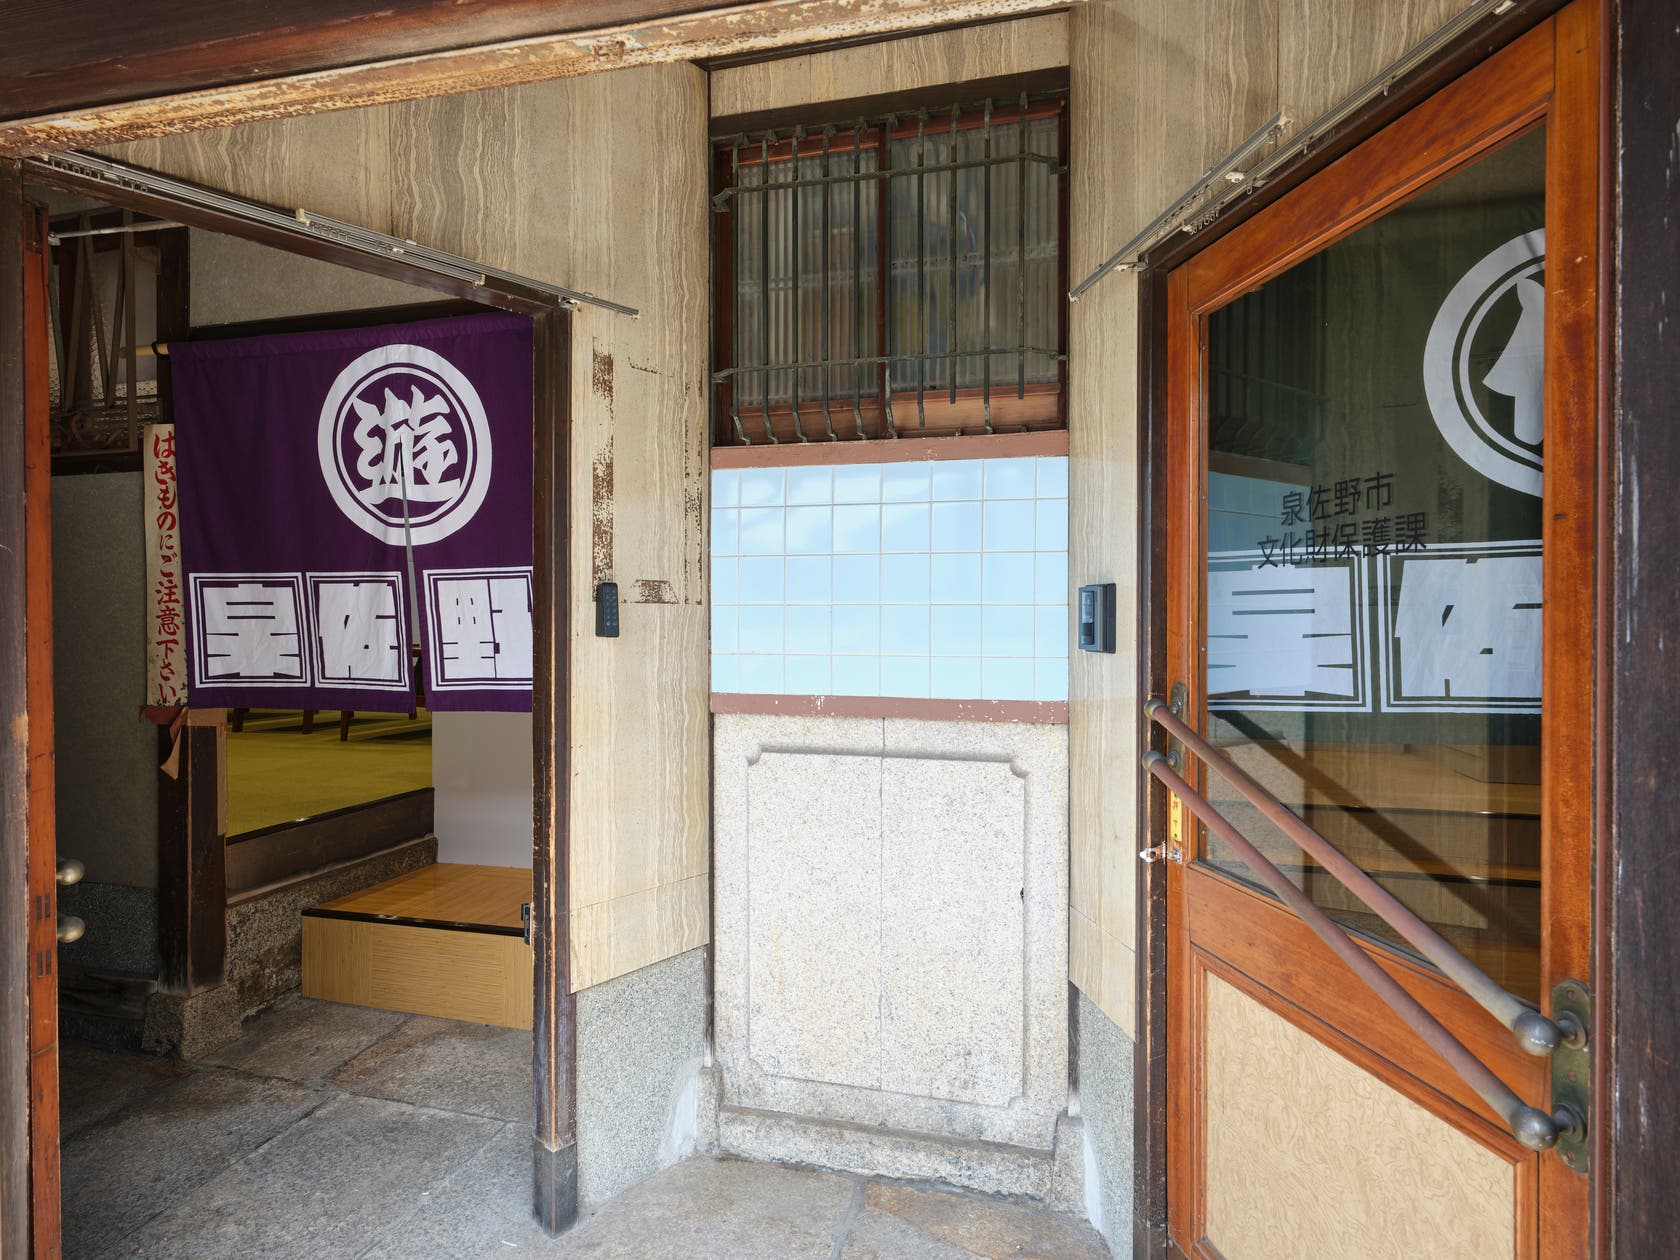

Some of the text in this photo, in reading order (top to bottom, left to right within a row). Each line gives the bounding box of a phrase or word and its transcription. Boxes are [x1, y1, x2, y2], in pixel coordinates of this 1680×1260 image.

[1281, 471, 1396, 526] 泉佐野市
[154, 431, 180, 703] はきものにご注意下さい
[1257, 511, 1427, 570] 文化財保護課
